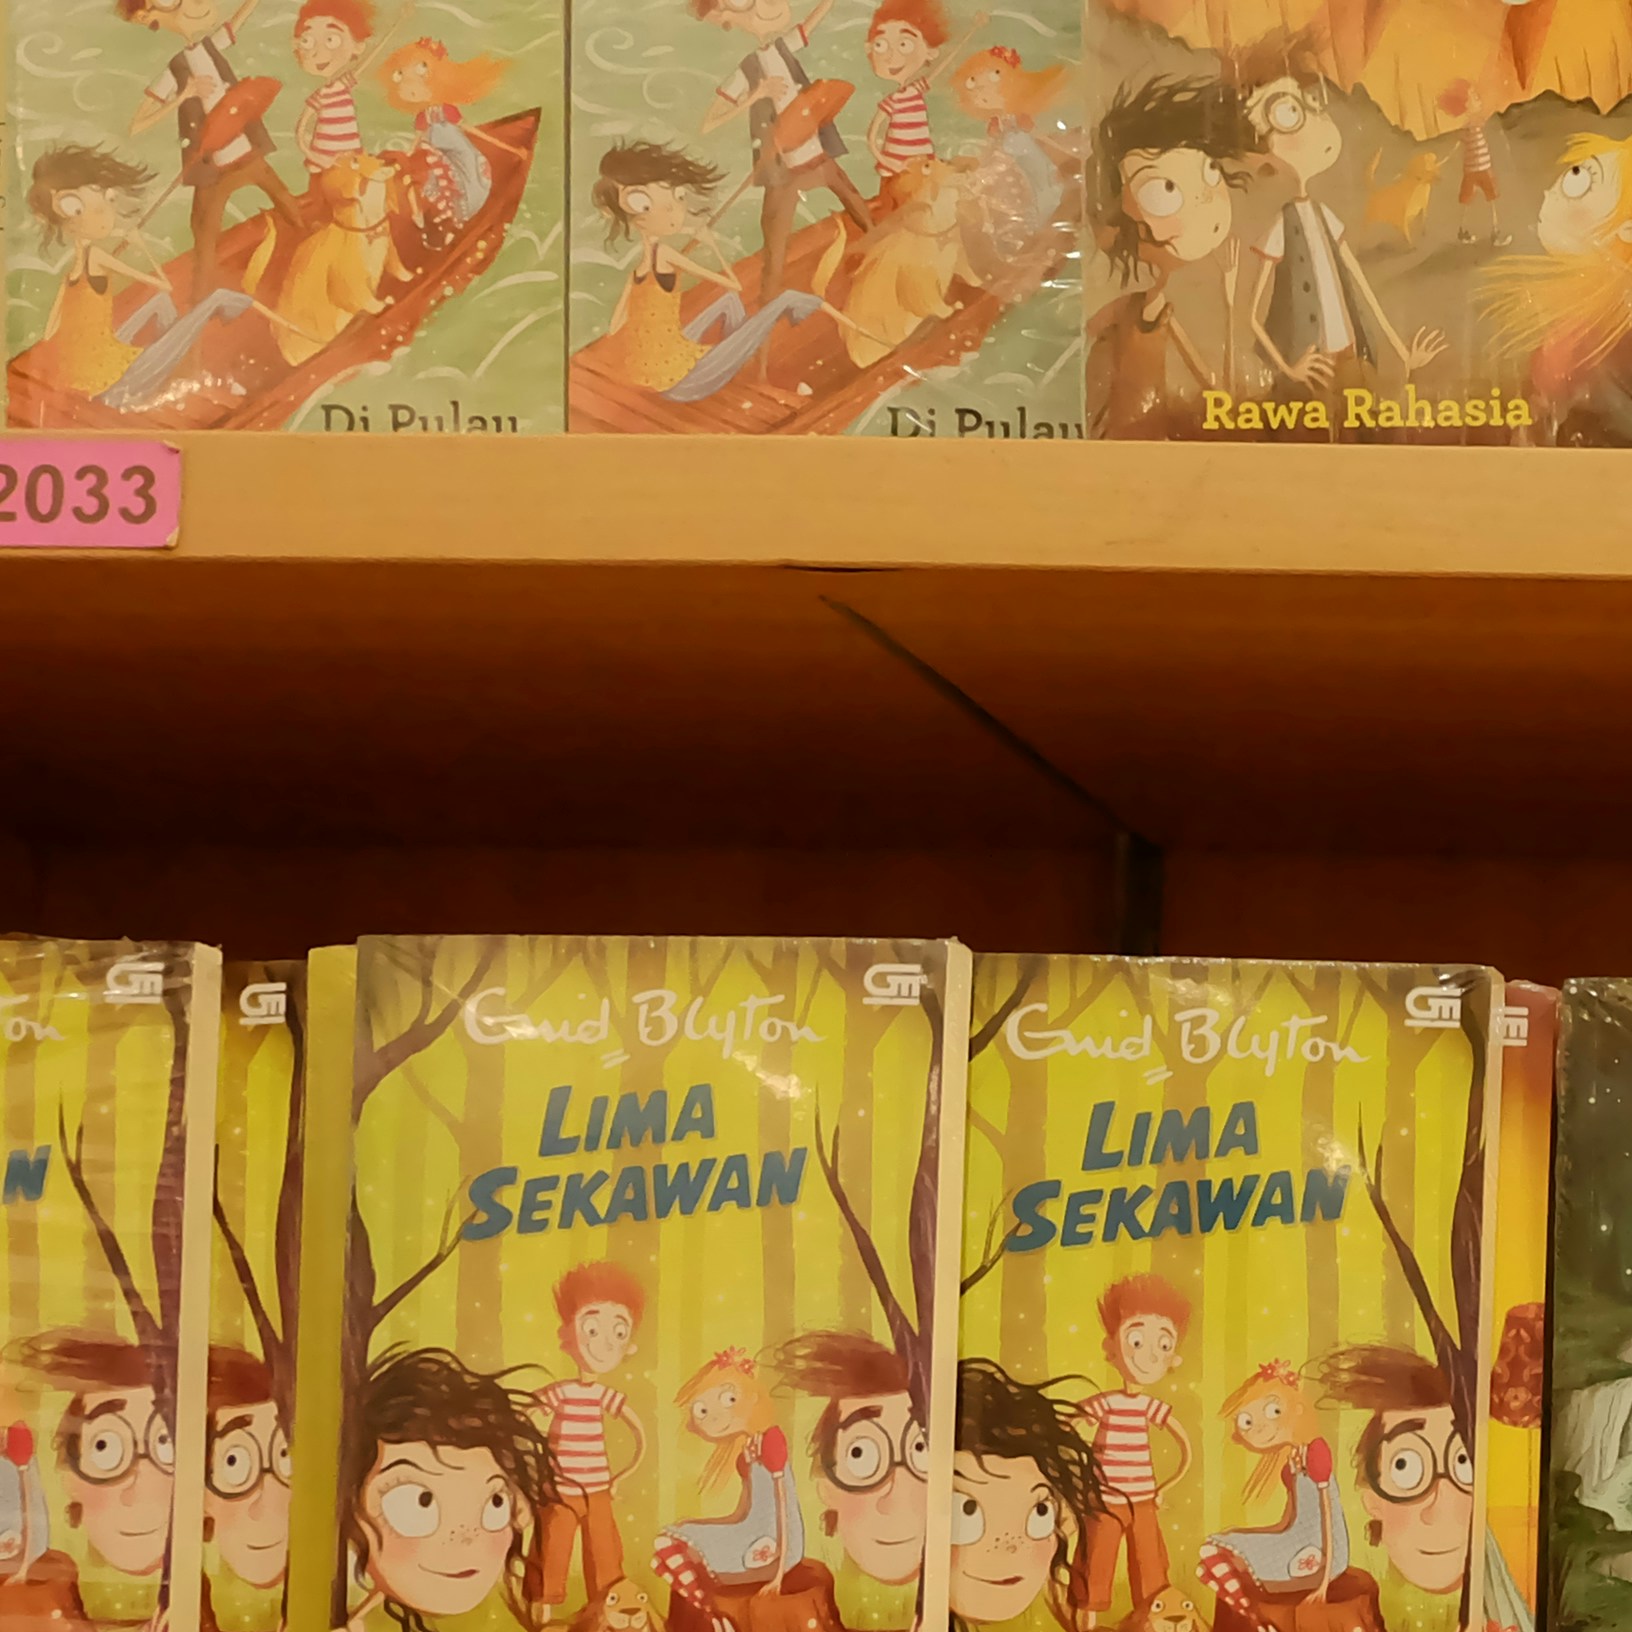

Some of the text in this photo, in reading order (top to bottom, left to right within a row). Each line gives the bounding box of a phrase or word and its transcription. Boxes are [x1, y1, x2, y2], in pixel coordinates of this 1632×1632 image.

[321, 404, 370, 432] Di
[1202, 386, 1533, 432] Rawa Rahasia
[464, 987, 826, 1058] Enid Blyton
[1006, 1002, 1370, 1077] Enid Blyton
[539, 1084, 714, 1158] LIMA
[1081, 1100, 1259, 1172] LIMA
[462, 1148, 807, 1242] SEKAWAN
[1006, 1165, 1352, 1252] SEKAWAN
